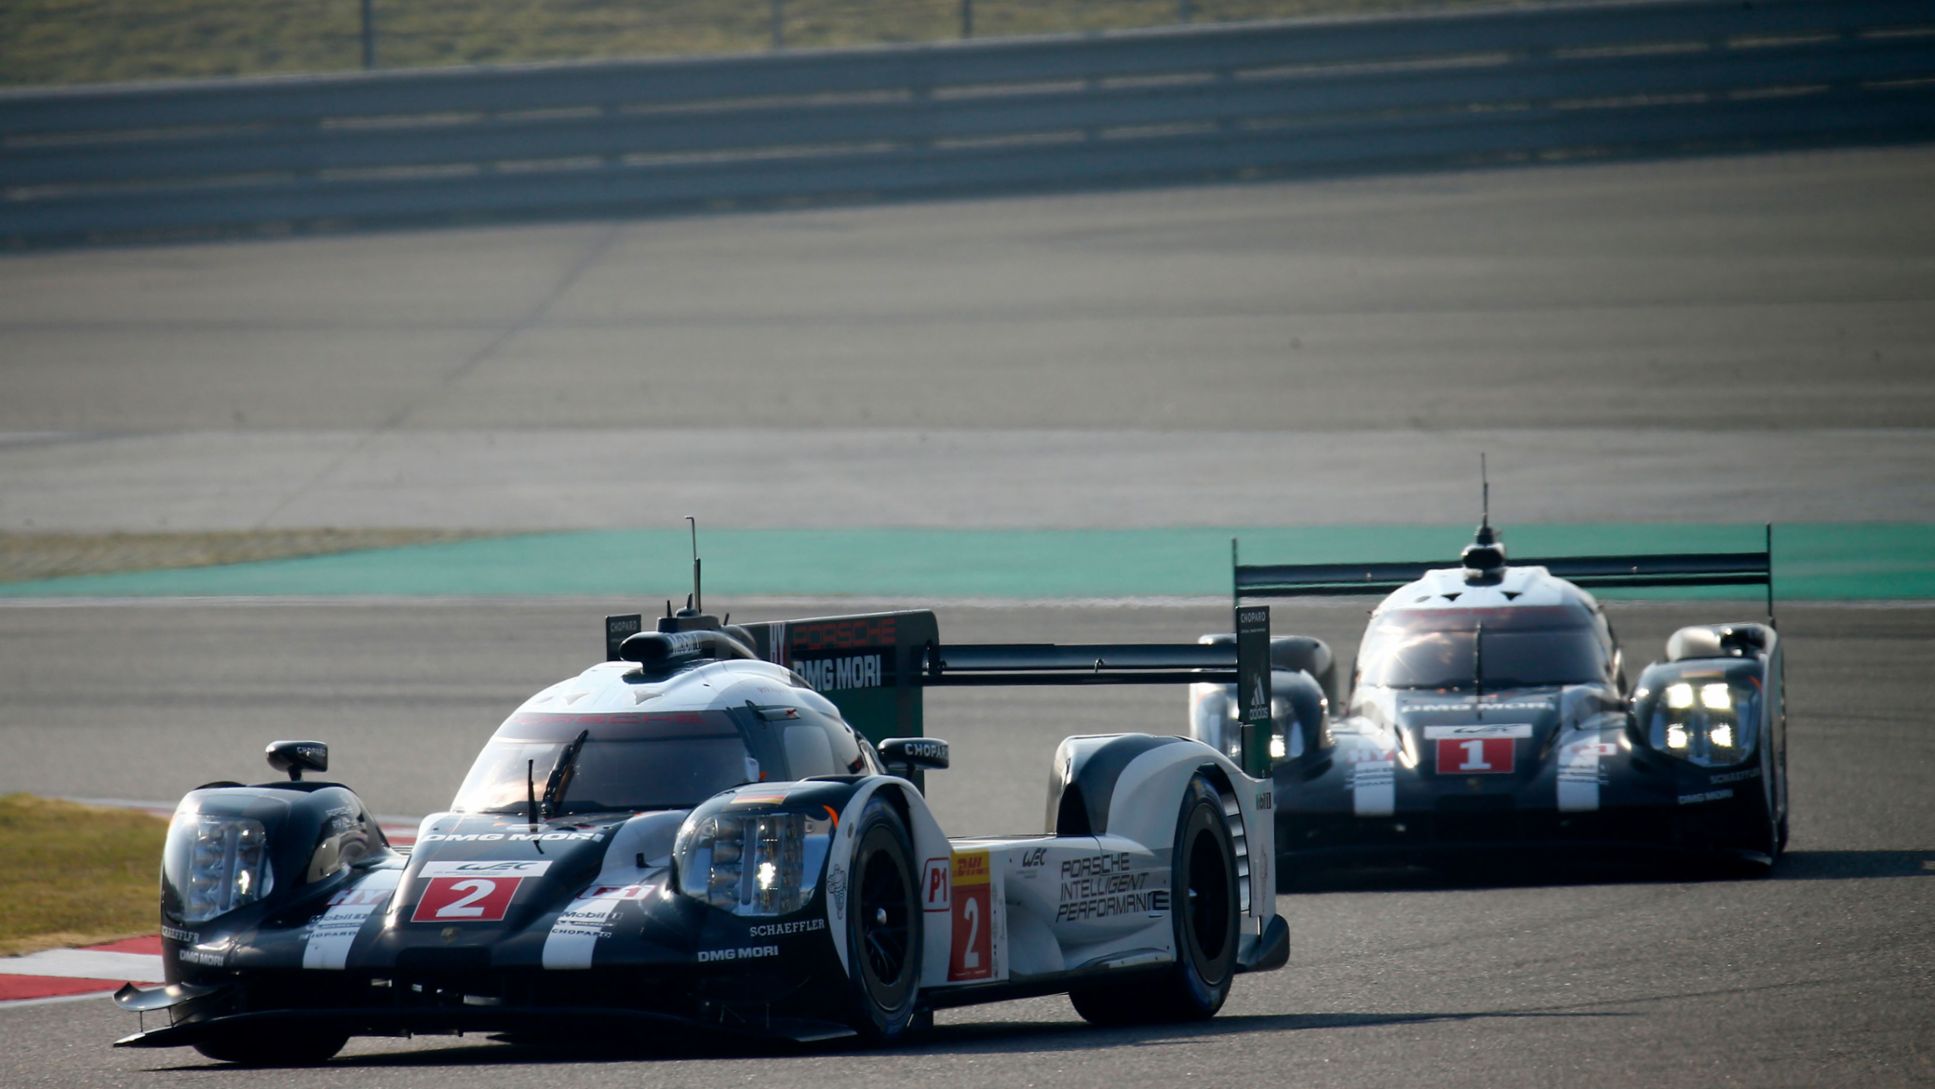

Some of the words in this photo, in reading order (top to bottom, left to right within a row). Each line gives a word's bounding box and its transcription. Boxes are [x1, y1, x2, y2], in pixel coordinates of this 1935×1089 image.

[793, 618, 897, 651] PORSCHE
[836, 654, 881, 689] MORI
[1459, 740, 1491, 770] 1
[426, 833, 504, 842] DMG
[1022, 848, 1047, 867] WEC
[1061, 852, 1130, 880] PORSCHE
[435, 879, 497, 917] 2
[928, 867, 948, 903] P1
[1060, 872, 1149, 901] INTELLIGENT
[561, 911, 606, 919] Mobil
[749, 919, 825, 937] SCHAEFFLER
[964, 897, 980, 970] 2
[697, 949, 736, 962] DMG
[738, 945, 779, 959] MORI
